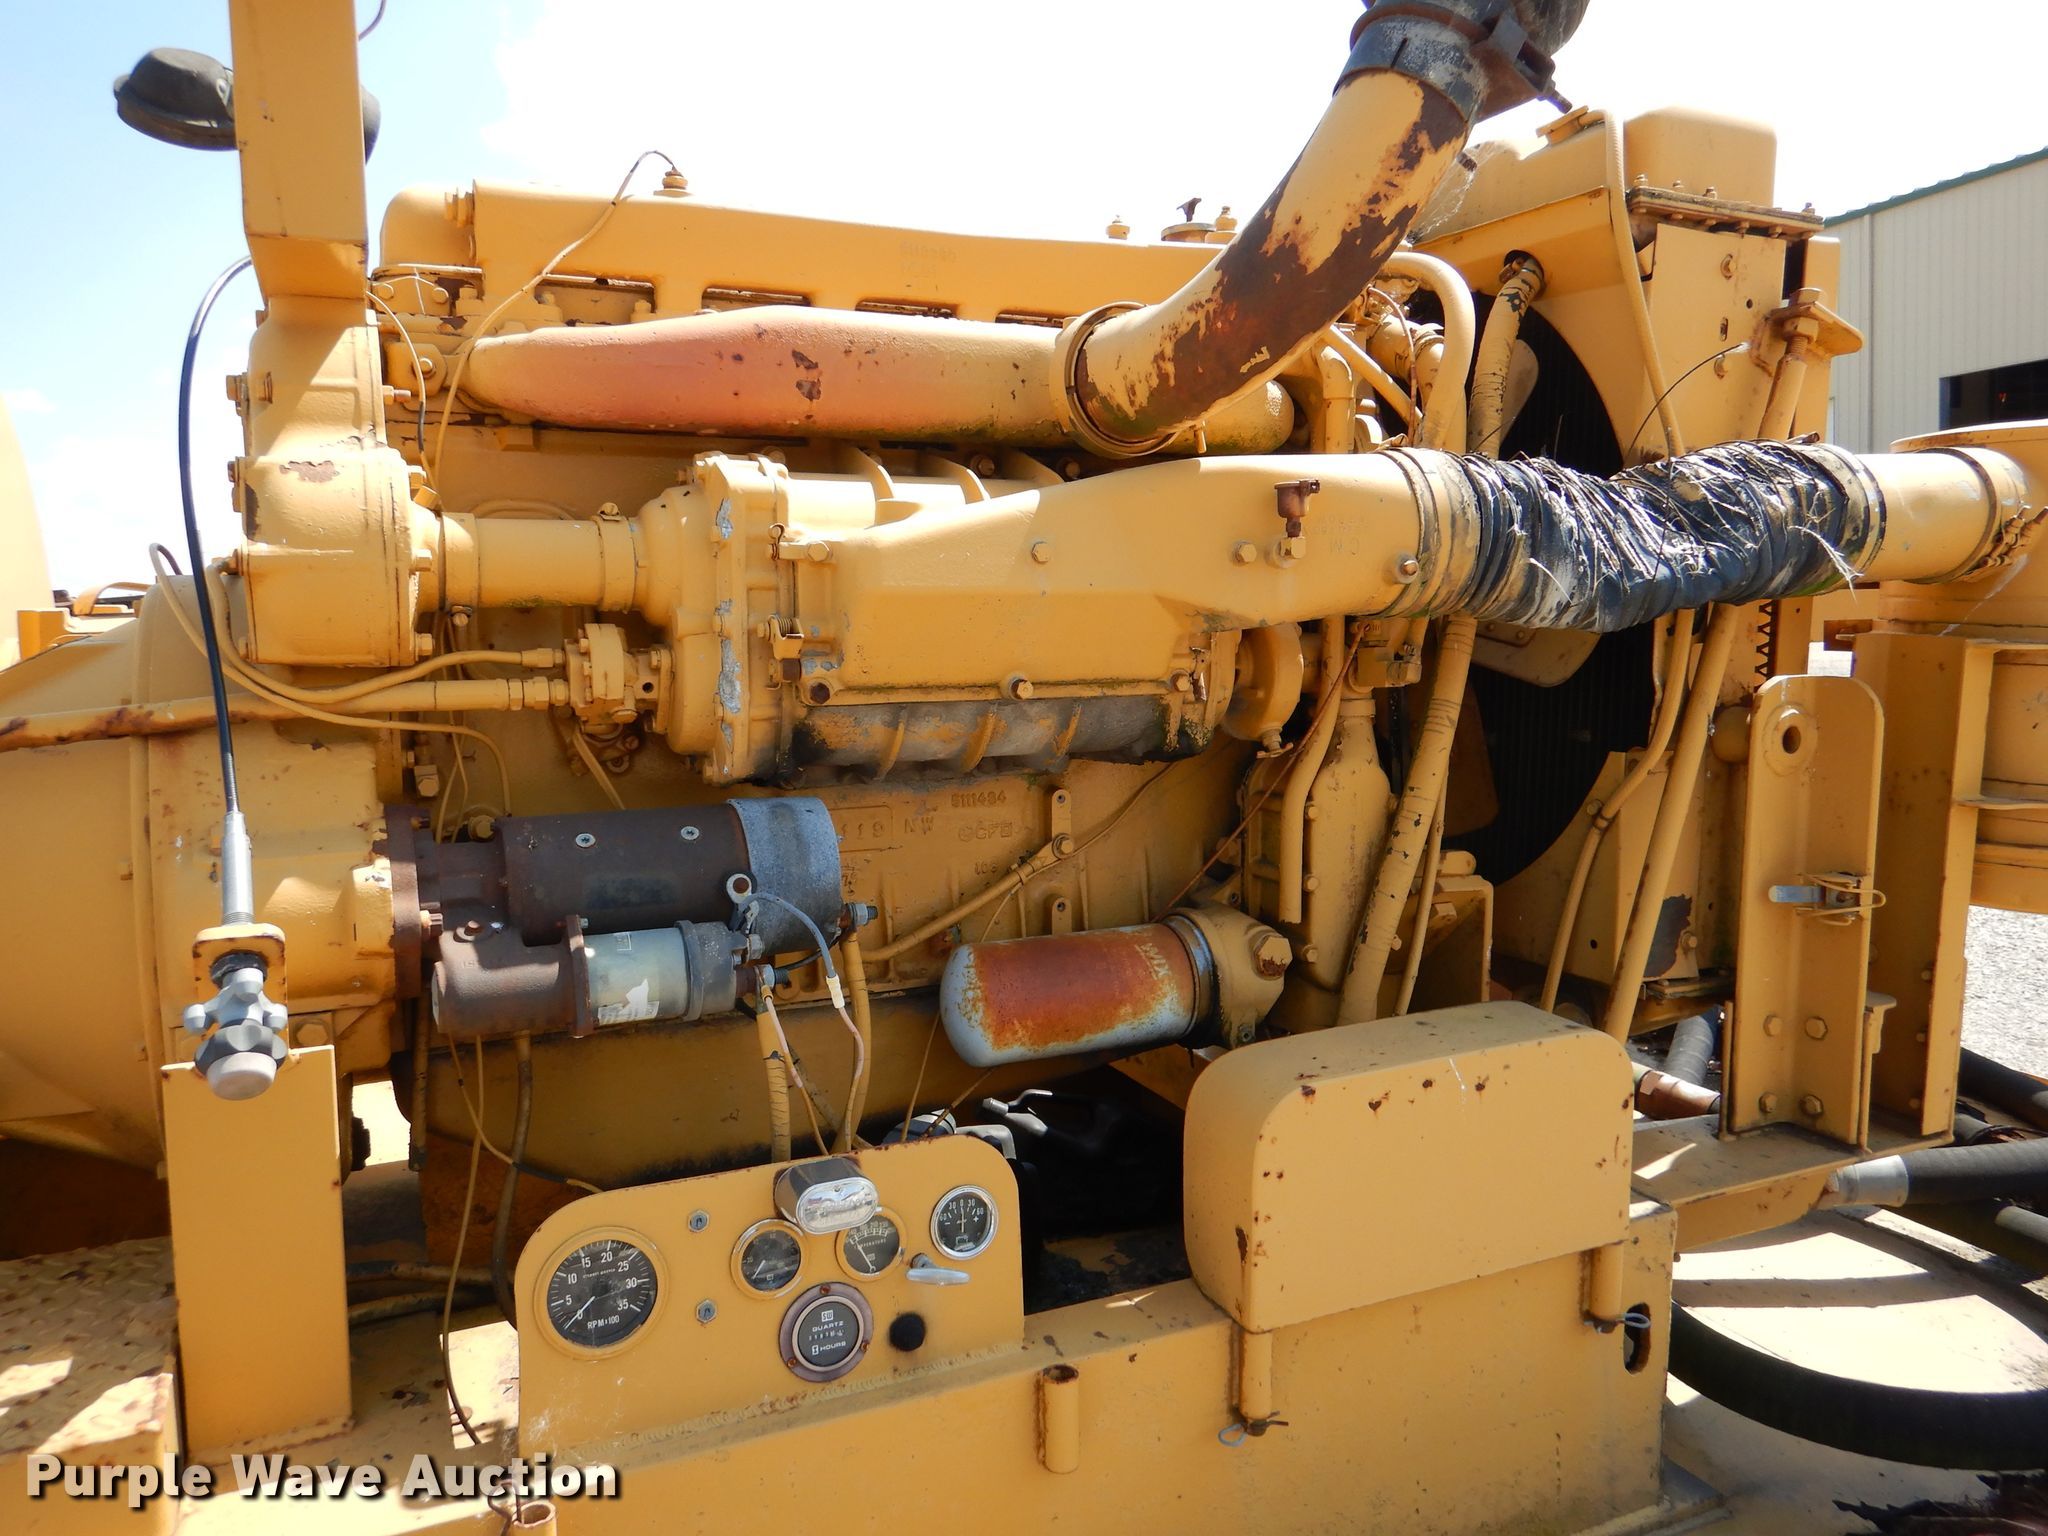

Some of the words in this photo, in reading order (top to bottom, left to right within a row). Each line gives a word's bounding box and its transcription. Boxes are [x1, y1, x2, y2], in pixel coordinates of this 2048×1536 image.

[582, 1257, 592, 1268] 15
[601, 1251, 613, 1263] 20
[618, 1260, 630, 1272] 25
[568, 1273, 578, 1284] 10
[625, 1277, 638, 1289] 30
[565, 1295, 573, 1306] 5
[617, 1299, 629, 1311] 35
[812, 1321, 844, 1332] QUARTZ
[820, 1340, 846, 1352] HOURS
